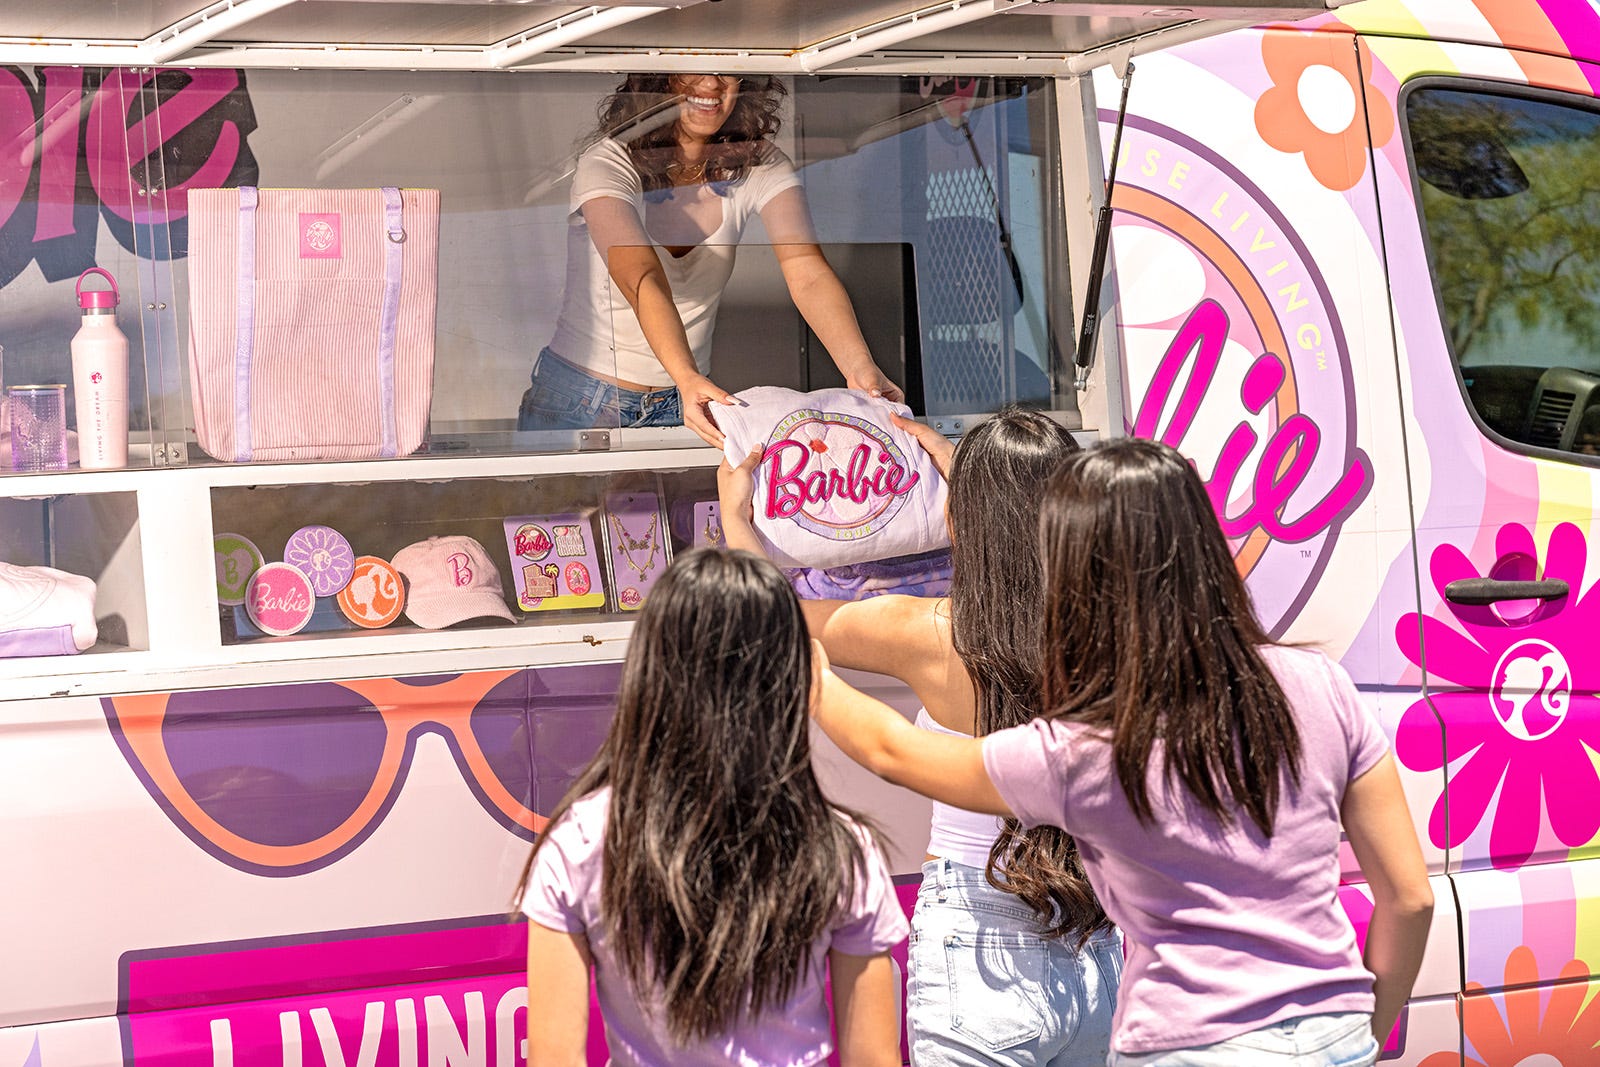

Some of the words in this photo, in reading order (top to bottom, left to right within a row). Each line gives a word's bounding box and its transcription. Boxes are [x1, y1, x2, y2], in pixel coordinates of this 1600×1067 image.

[760, 438, 921, 520] Barbie
[513, 531, 554, 556] Barbie
[835, 525, 872, 539] TOUR
[1300, 550, 1312, 558] TM
[223, 557, 238, 586] B
[447, 552, 473, 587] B
[253, 582, 310, 614] Barbie
